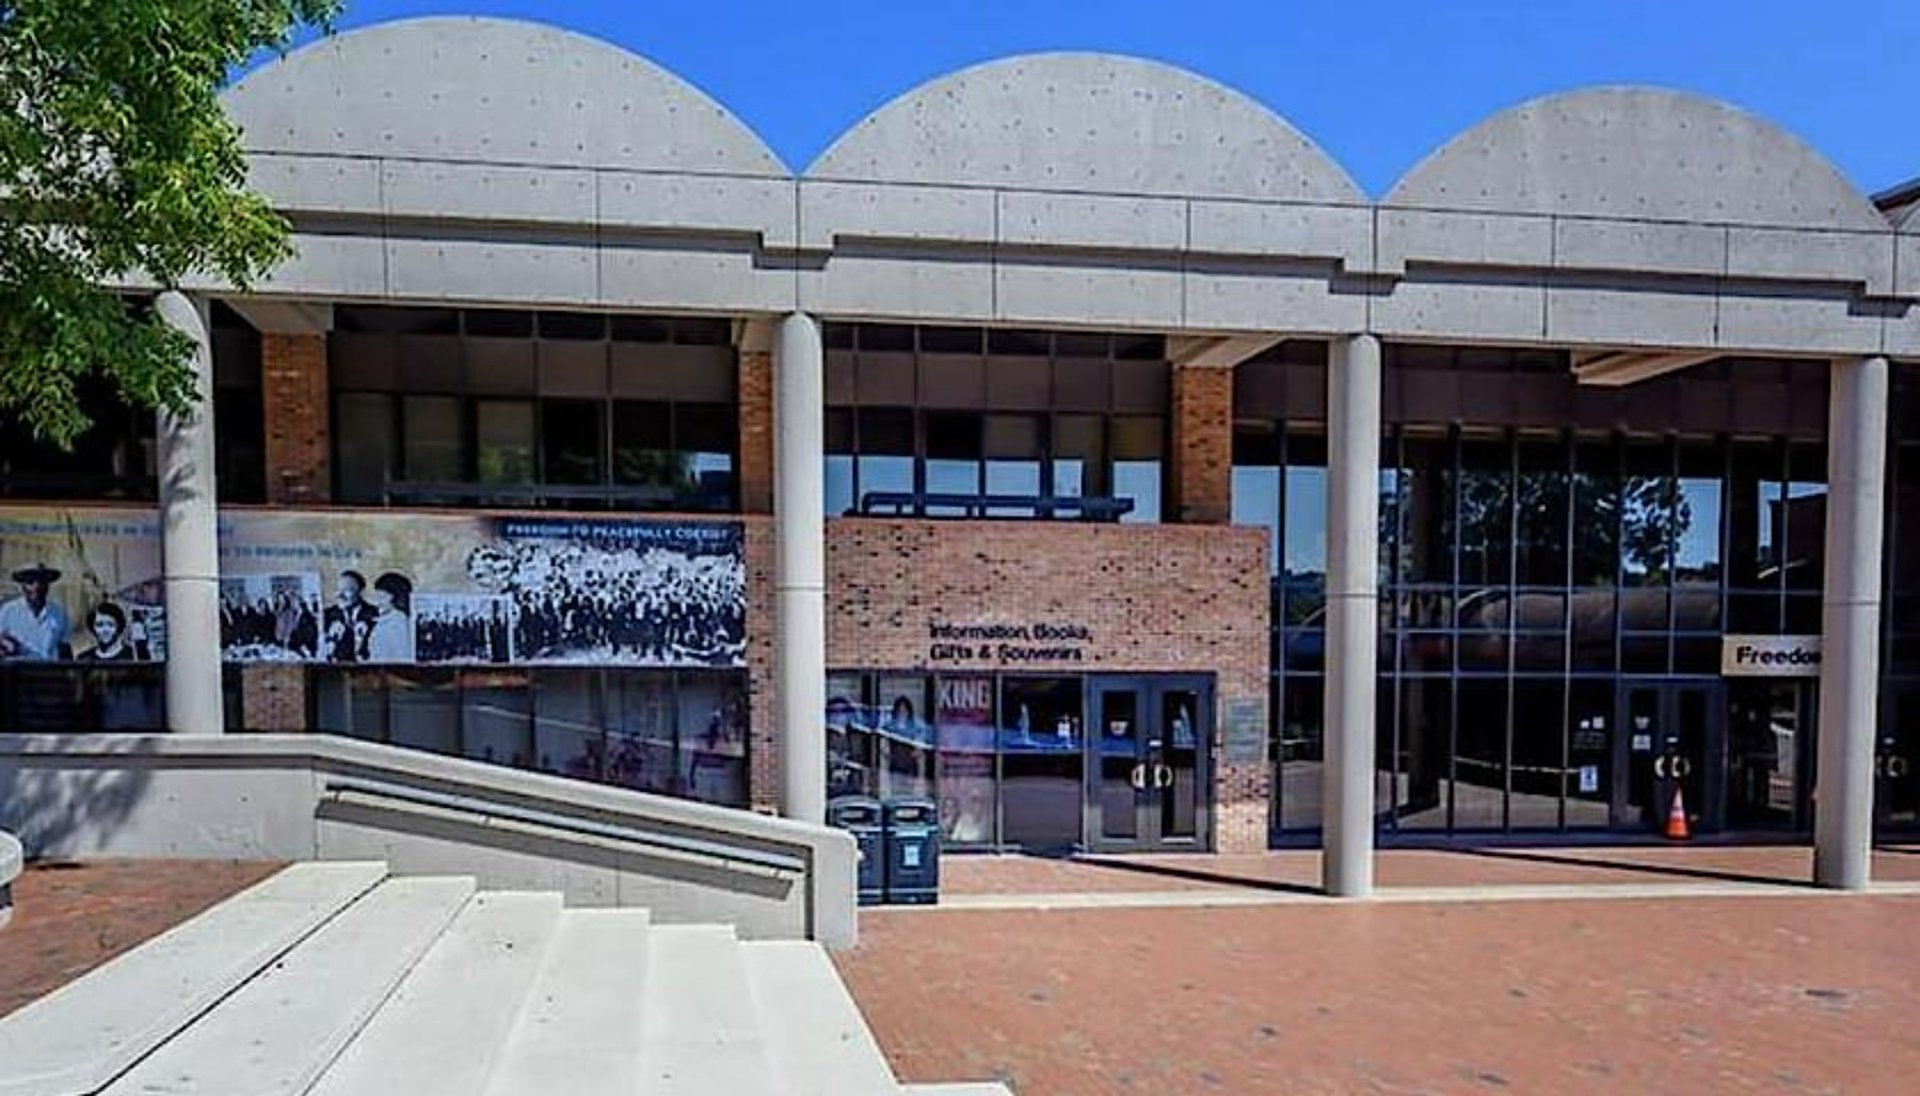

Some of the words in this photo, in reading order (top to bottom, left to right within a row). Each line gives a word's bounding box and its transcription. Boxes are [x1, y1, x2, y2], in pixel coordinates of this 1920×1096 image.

[929, 622, 1030, 641] Information,
[1033, 622, 1093, 644] Books,
[929, 643, 973, 660] Gifts
[979, 644, 991, 659] &
[998, 643, 1082, 661] Souvenirs
[939, 679, 989, 709] KING
